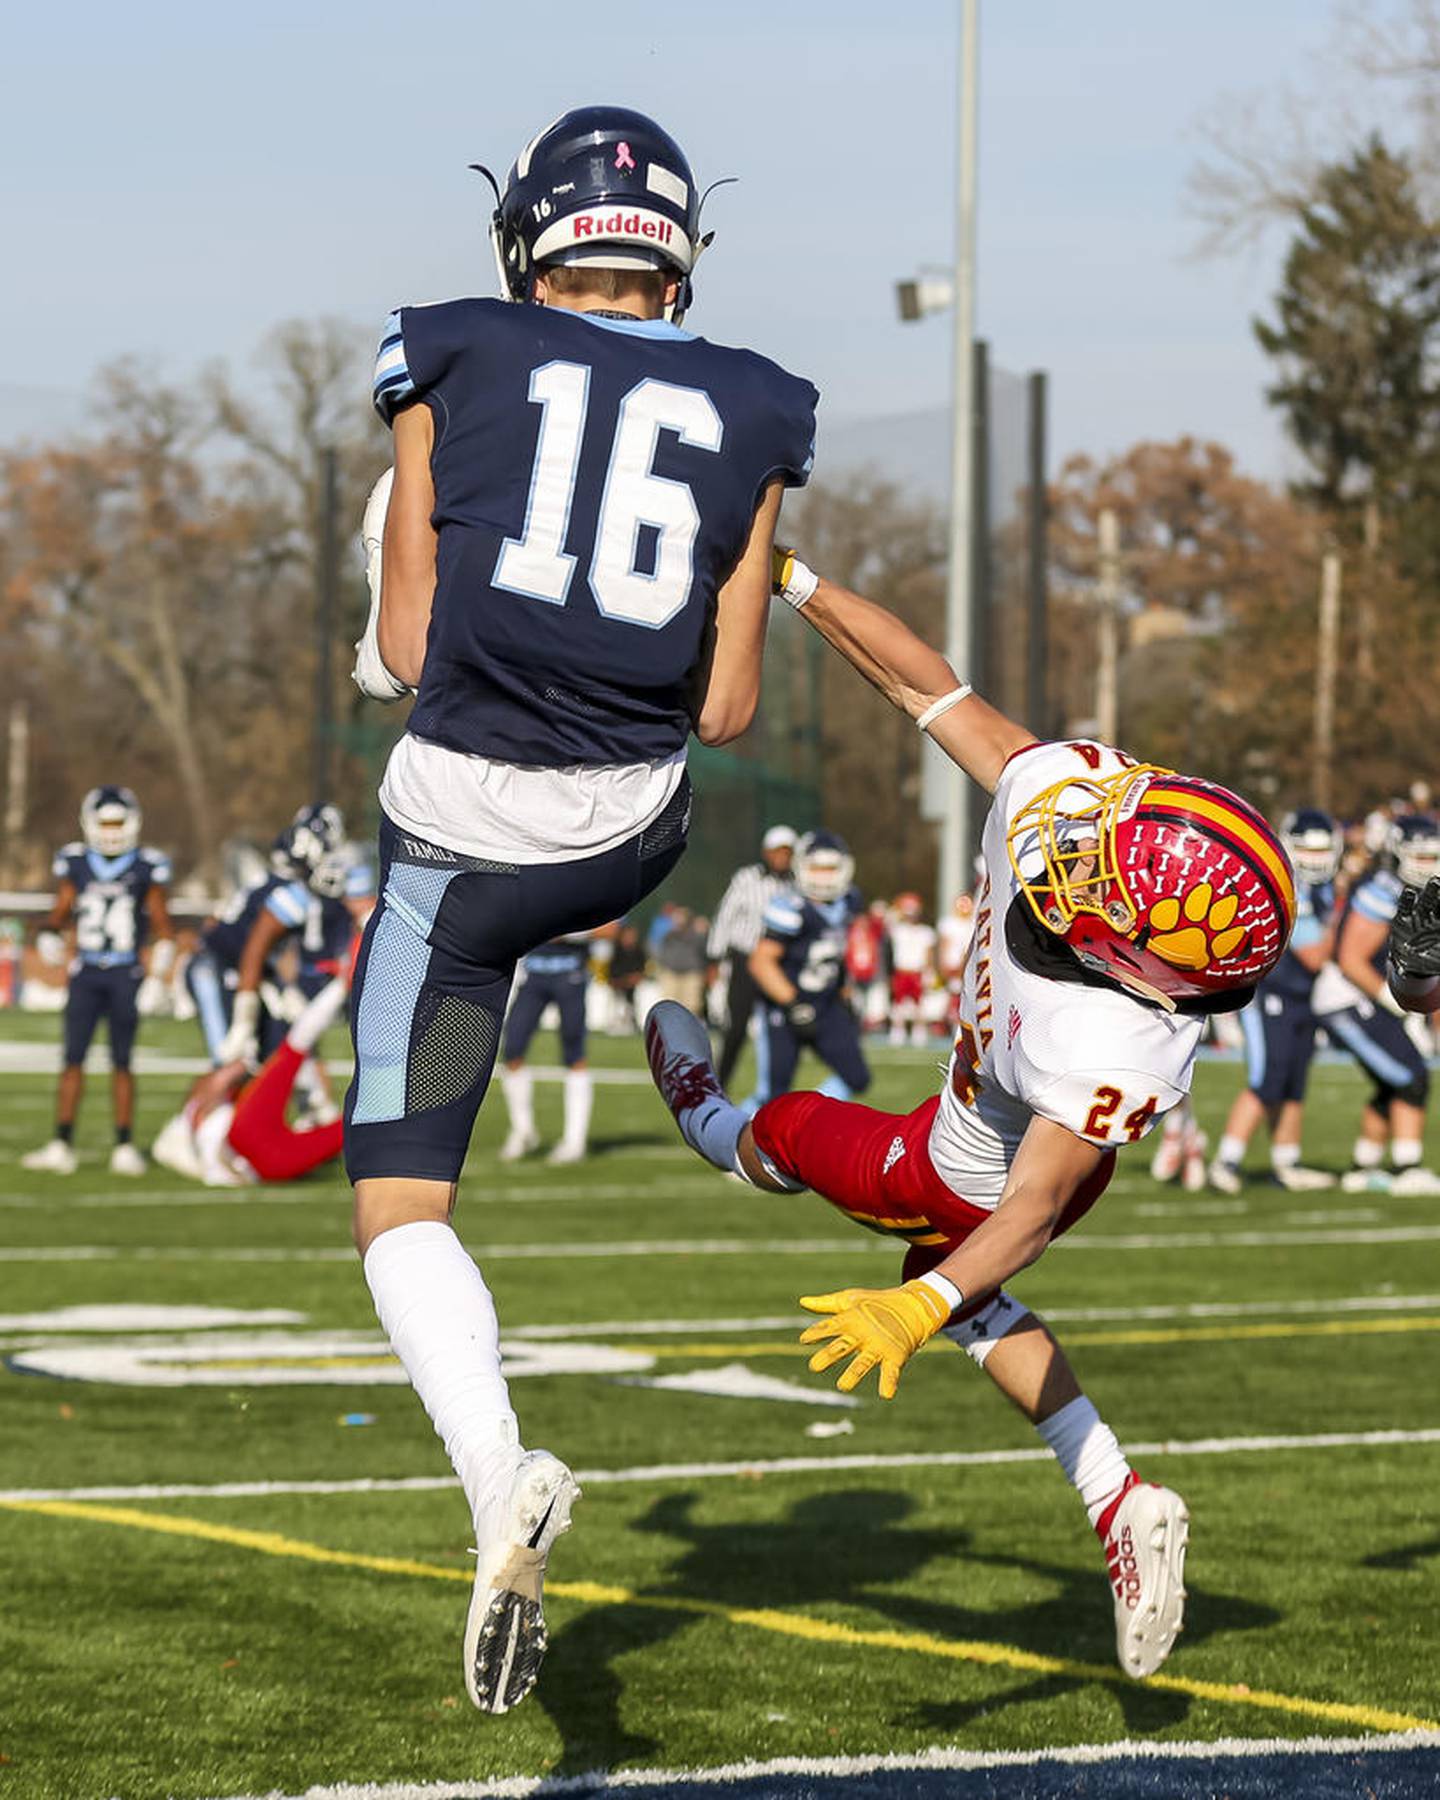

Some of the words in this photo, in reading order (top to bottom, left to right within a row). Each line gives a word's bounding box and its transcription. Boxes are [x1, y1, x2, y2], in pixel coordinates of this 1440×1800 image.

[532, 198, 552, 222] 16
[574, 213, 672, 244] Riddell
[490, 359, 724, 630] 16
[77, 894, 135, 952] 24
[1083, 1085, 1158, 1142] 24
[1121, 1525, 1141, 1609] adidas
